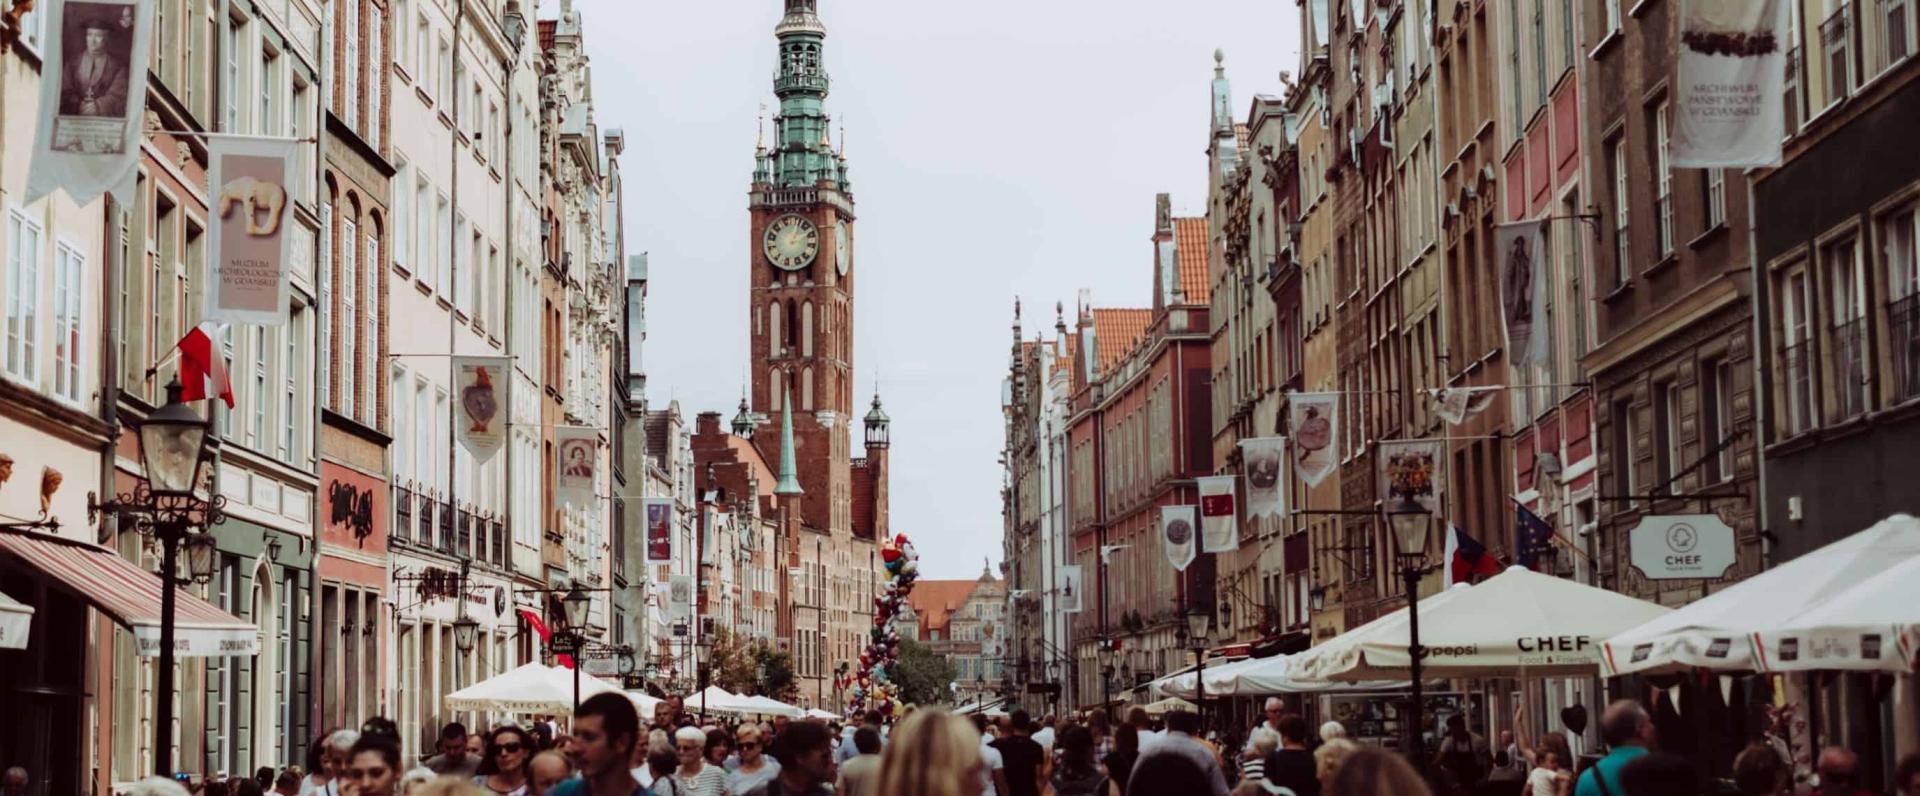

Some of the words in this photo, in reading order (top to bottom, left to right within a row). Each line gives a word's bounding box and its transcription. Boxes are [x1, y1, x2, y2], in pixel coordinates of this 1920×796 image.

[231, 259, 269, 268] MUZEUM
[1664, 555, 1702, 566] CHEF
[1517, 635, 1590, 653] CHEF
[1432, 643, 1478, 658] pepsi
[1519, 656, 1544, 665] Food
